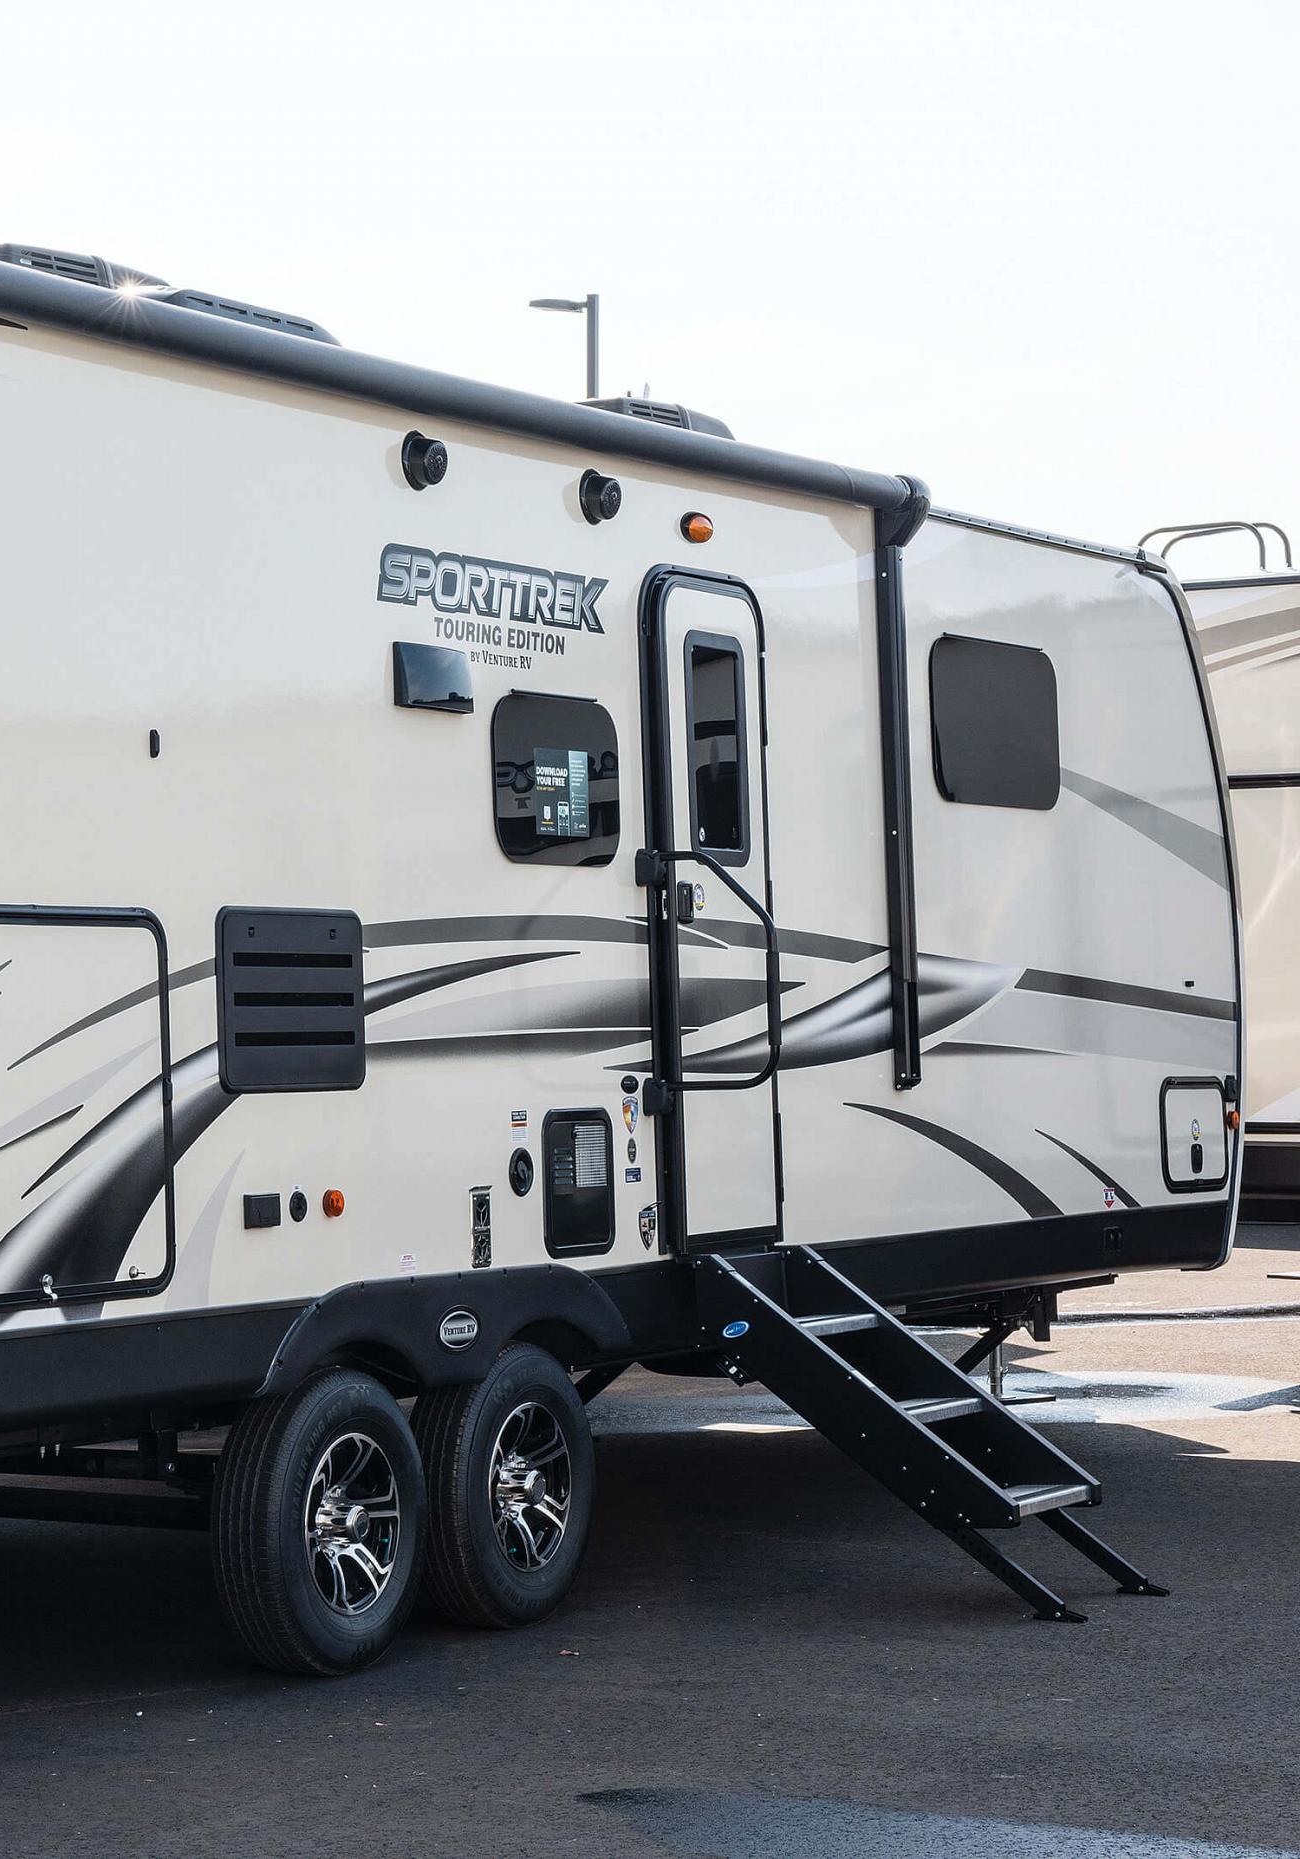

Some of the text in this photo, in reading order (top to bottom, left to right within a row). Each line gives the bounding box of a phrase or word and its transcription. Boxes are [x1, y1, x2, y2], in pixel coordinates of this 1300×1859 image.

[377, 543, 609, 634] SPORTTREK
[434, 617, 565, 655] TOURING EDITION
[470, 651, 481, 663] BY
[519, 655, 532, 670] RV
[536, 766, 568, 777] DOWNLOAD
[536, 776, 566, 787] YOUR FREE
